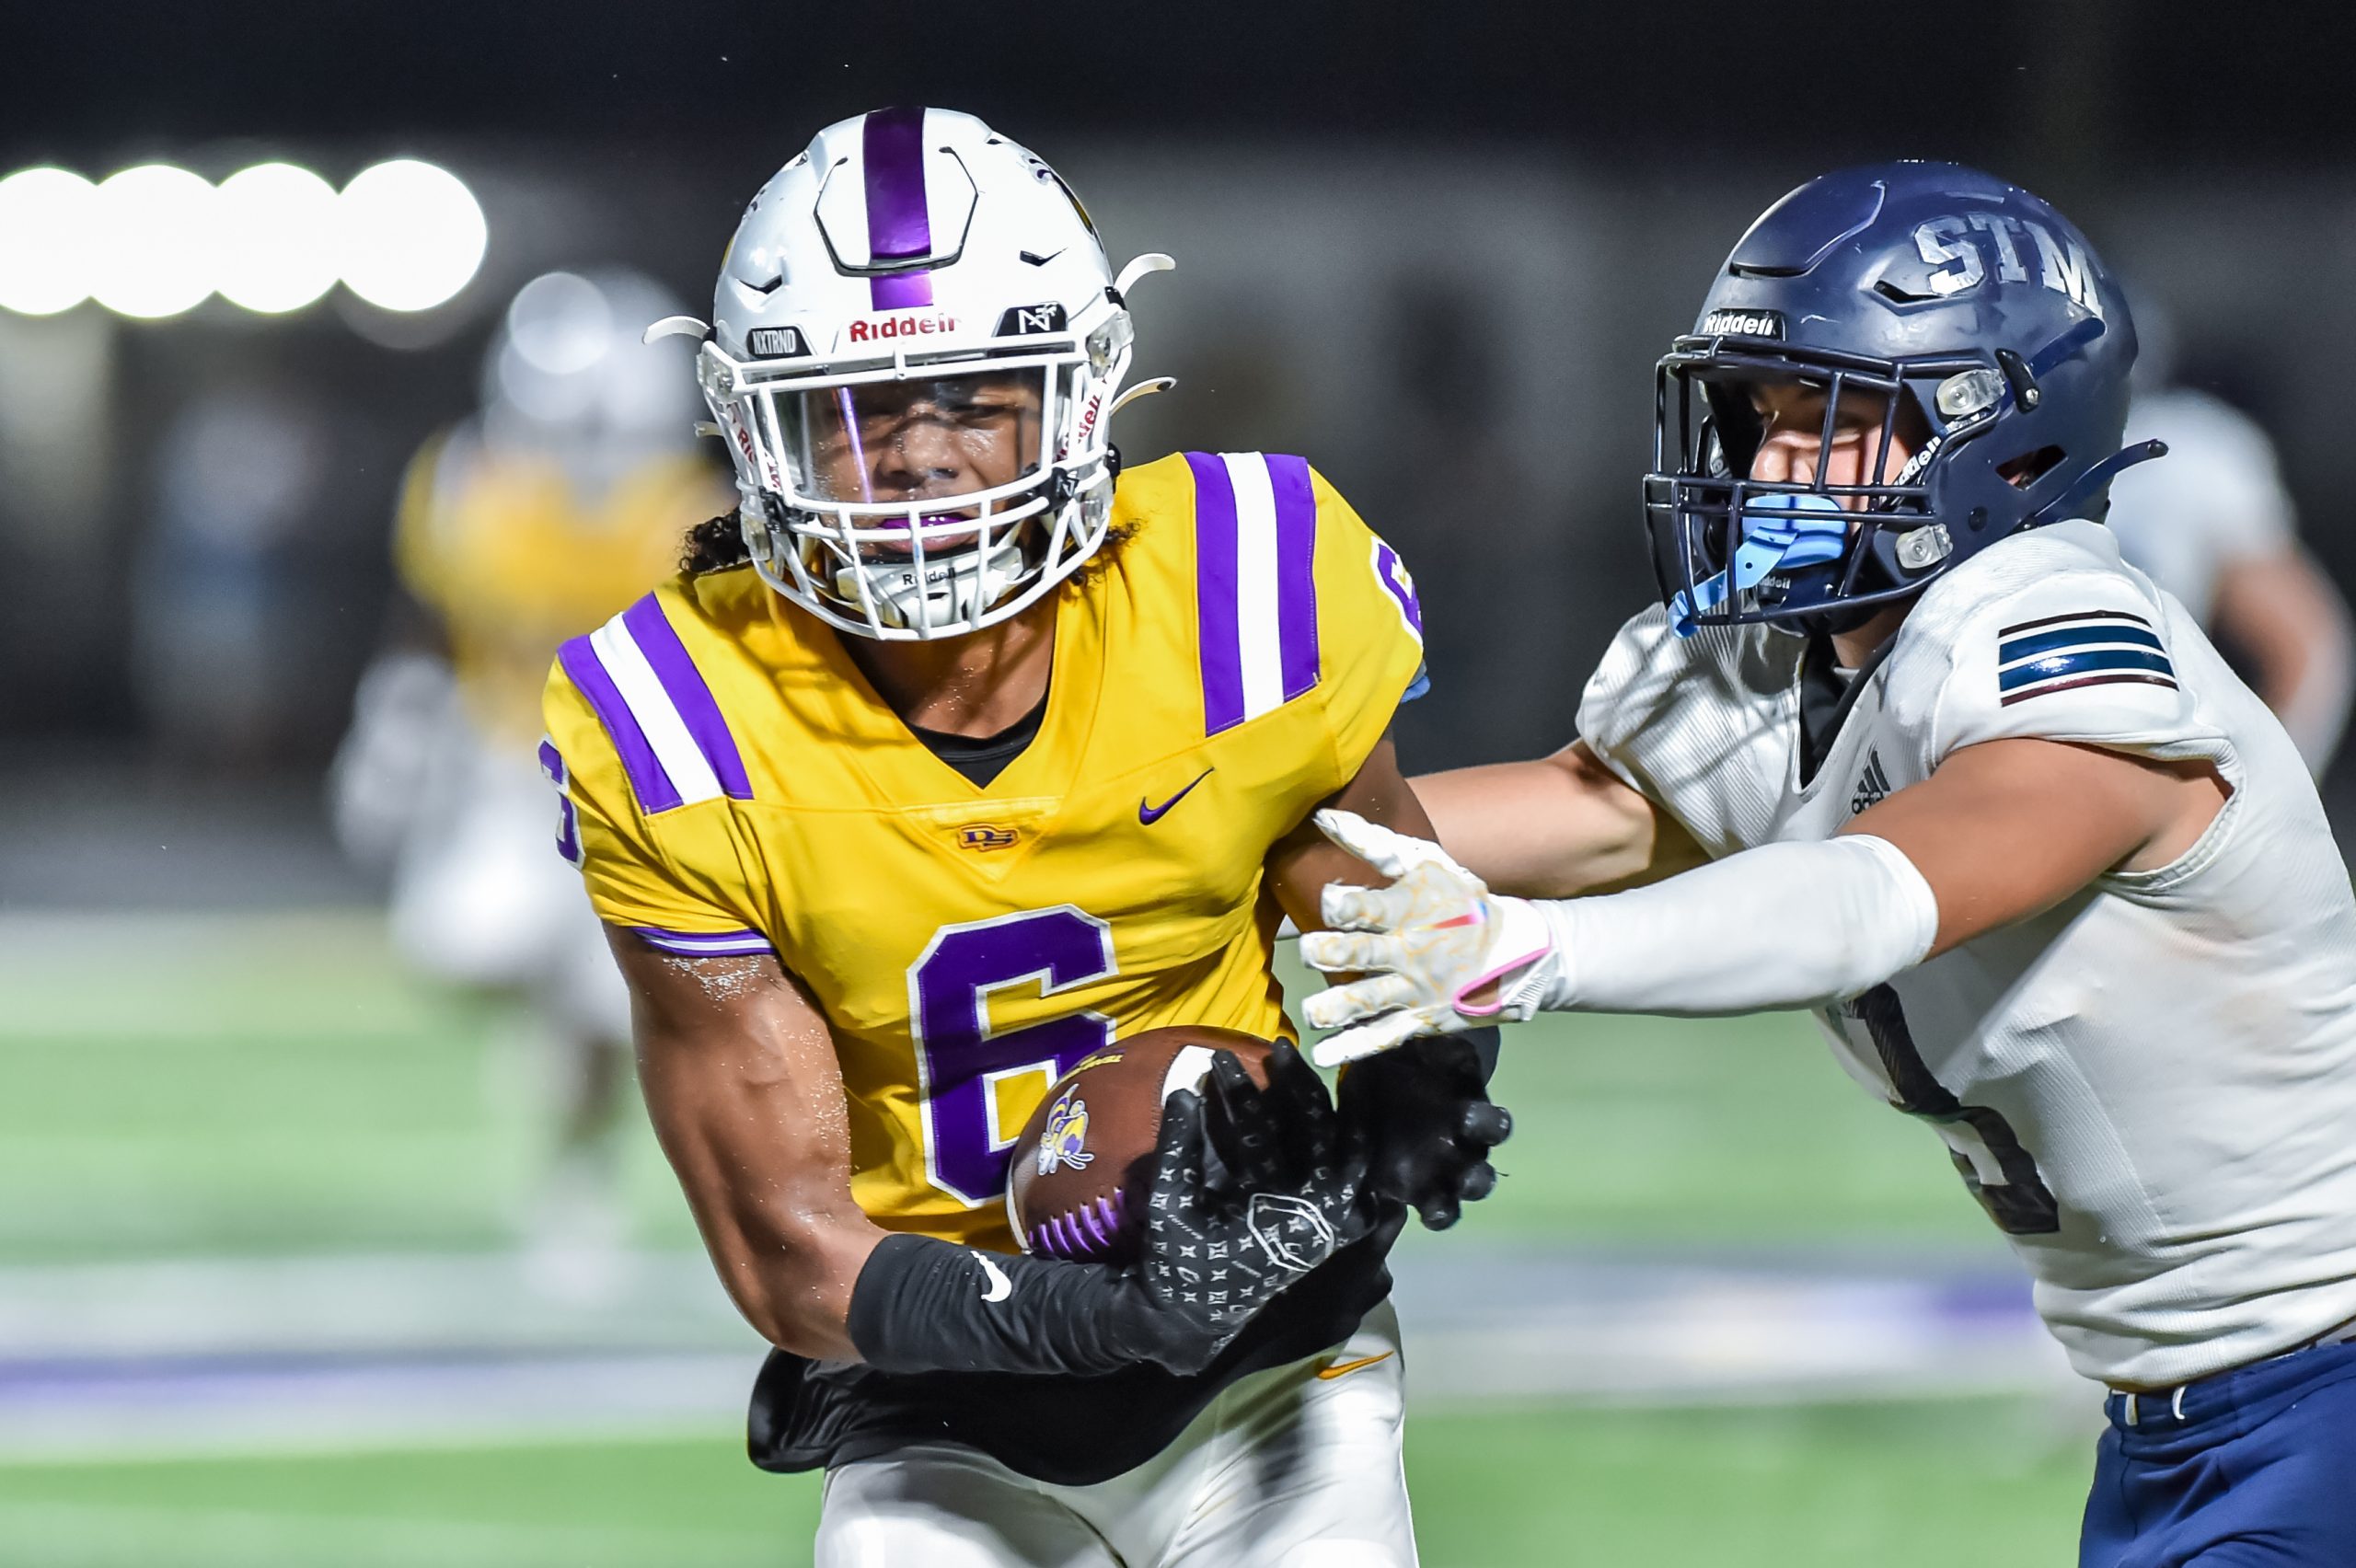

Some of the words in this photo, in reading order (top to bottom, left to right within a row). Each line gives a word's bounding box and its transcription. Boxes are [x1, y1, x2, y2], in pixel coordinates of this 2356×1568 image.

[1913, 213, 2104, 318] STM
[1703, 313, 1774, 336] Riddell
[752, 329, 797, 355] NXTRND
[902, 567, 956, 586] Rdell
[906, 903, 1119, 1209] 6
